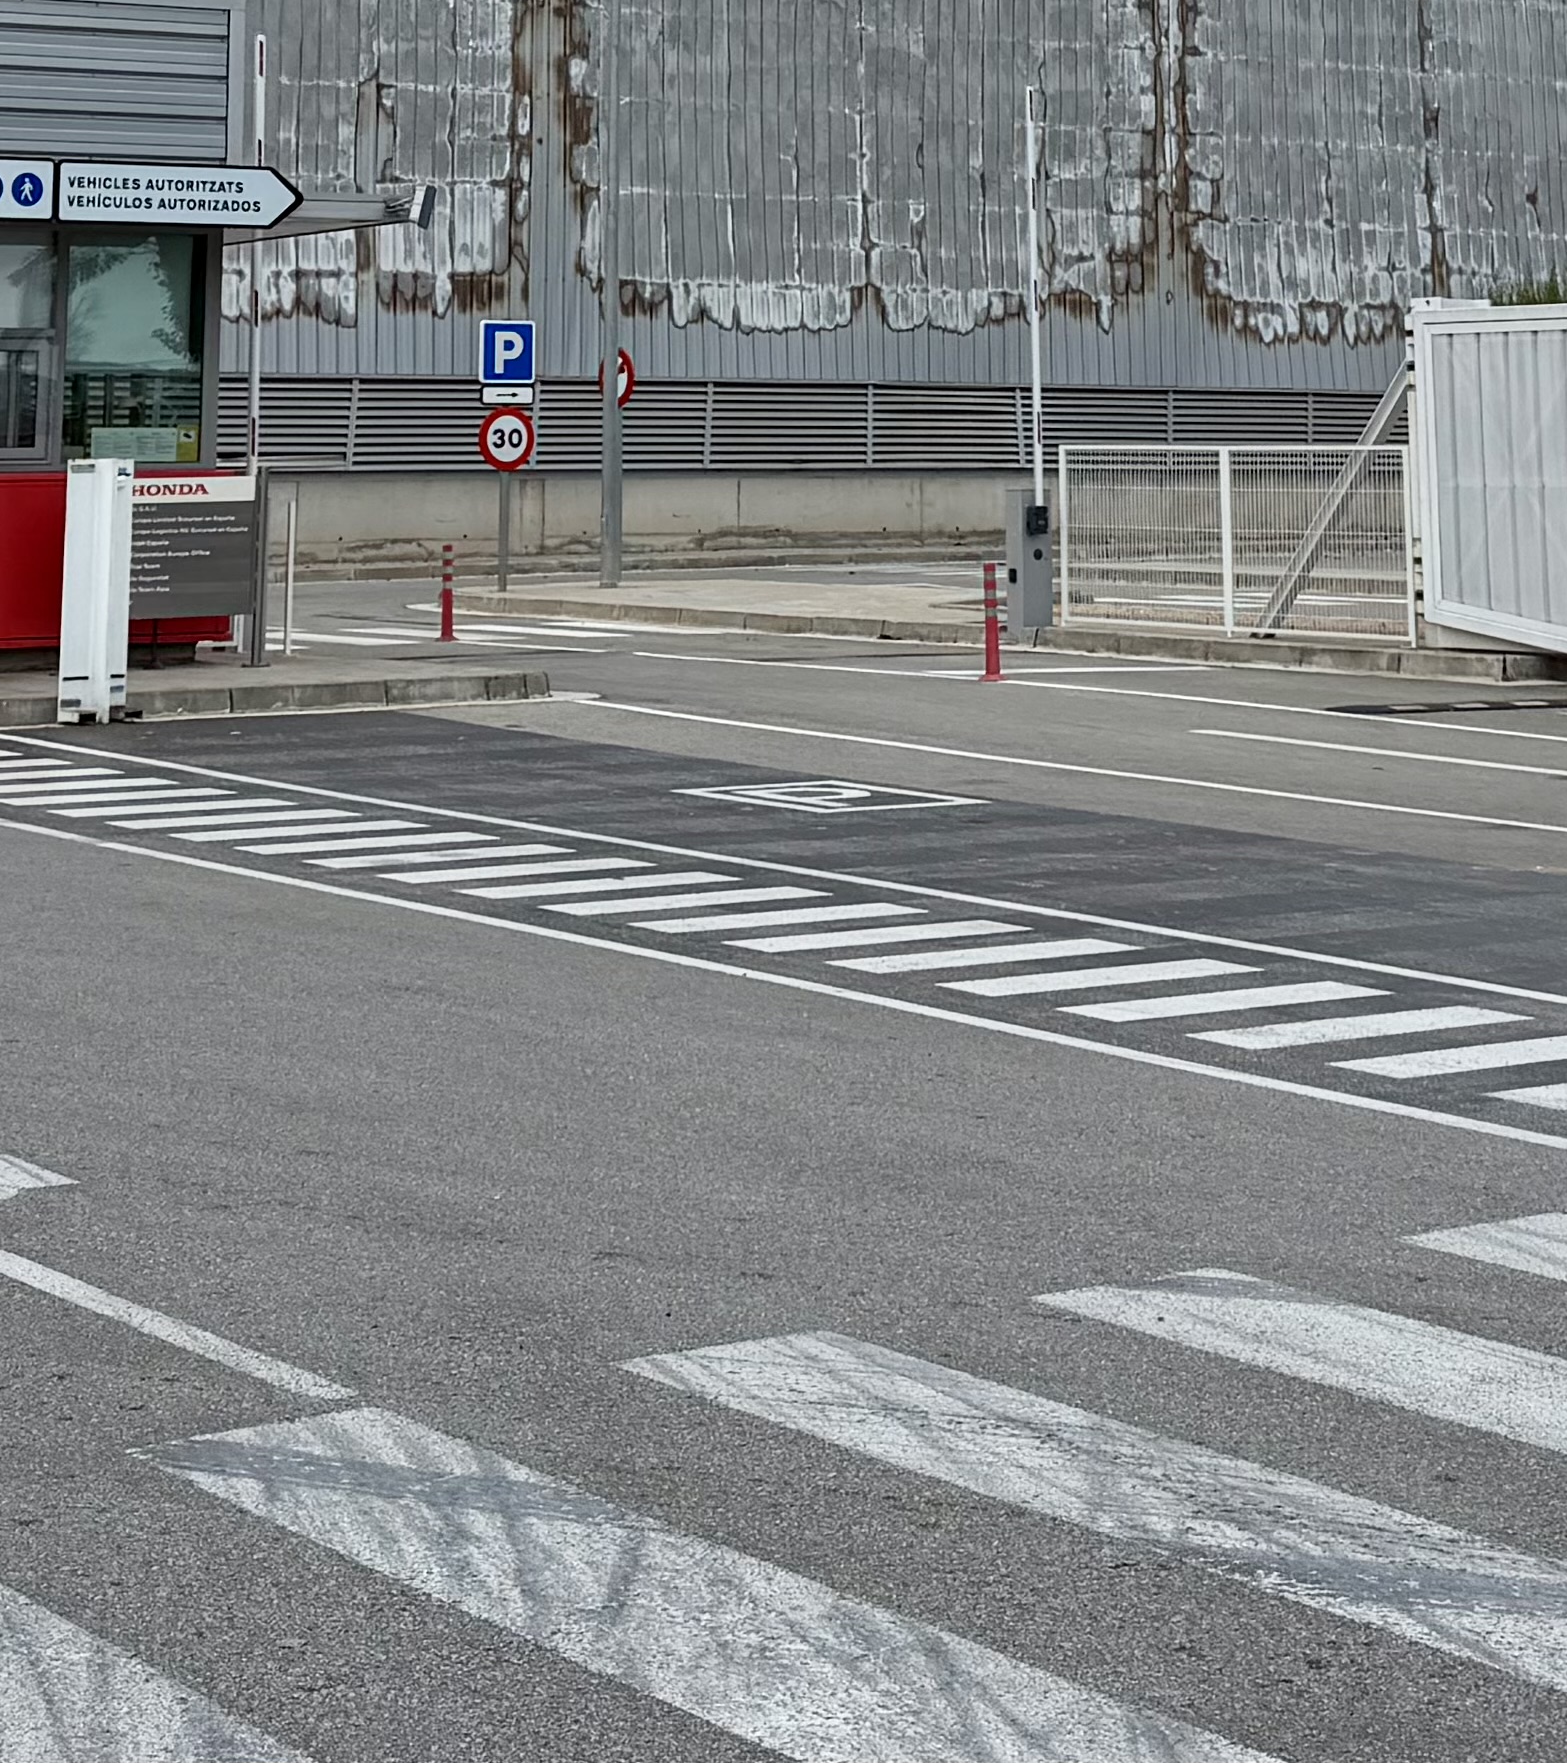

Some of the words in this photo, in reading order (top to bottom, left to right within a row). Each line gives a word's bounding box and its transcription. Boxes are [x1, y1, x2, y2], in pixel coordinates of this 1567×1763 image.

[67, 176, 141, 190] VEHICLES
[145, 179, 244, 193] AUTORITZATS
[67, 193, 153, 209] VEHÍCULOS
[157, 198, 261, 212] AUTORIZADOS
[494, 331, 524, 374] P
[492, 428, 523, 448] 30
[132, 483, 209, 497] HONDA
